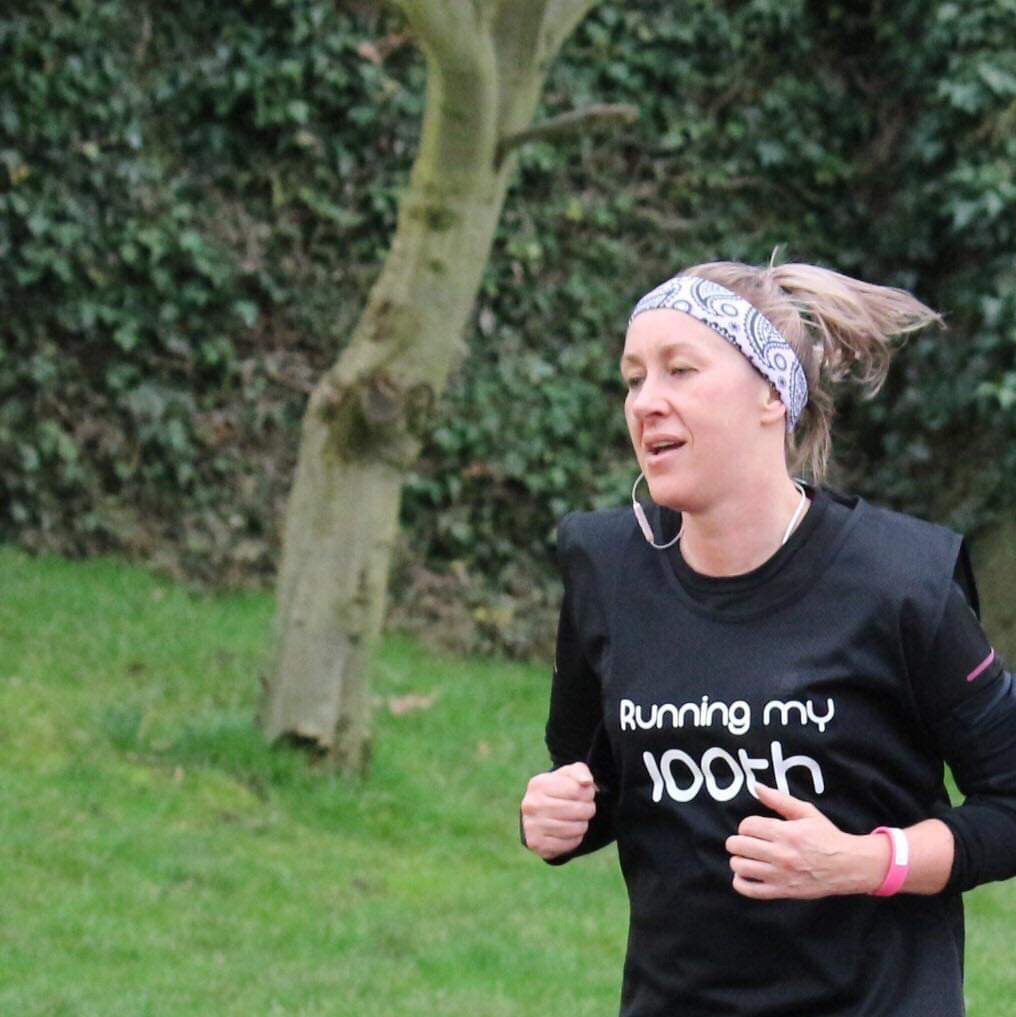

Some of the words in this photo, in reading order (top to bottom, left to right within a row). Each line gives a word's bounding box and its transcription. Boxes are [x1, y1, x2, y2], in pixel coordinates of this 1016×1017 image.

[619, 695, 751, 736] Running
[763, 698, 835, 733] my
[642, 740, 825, 803] 100th
